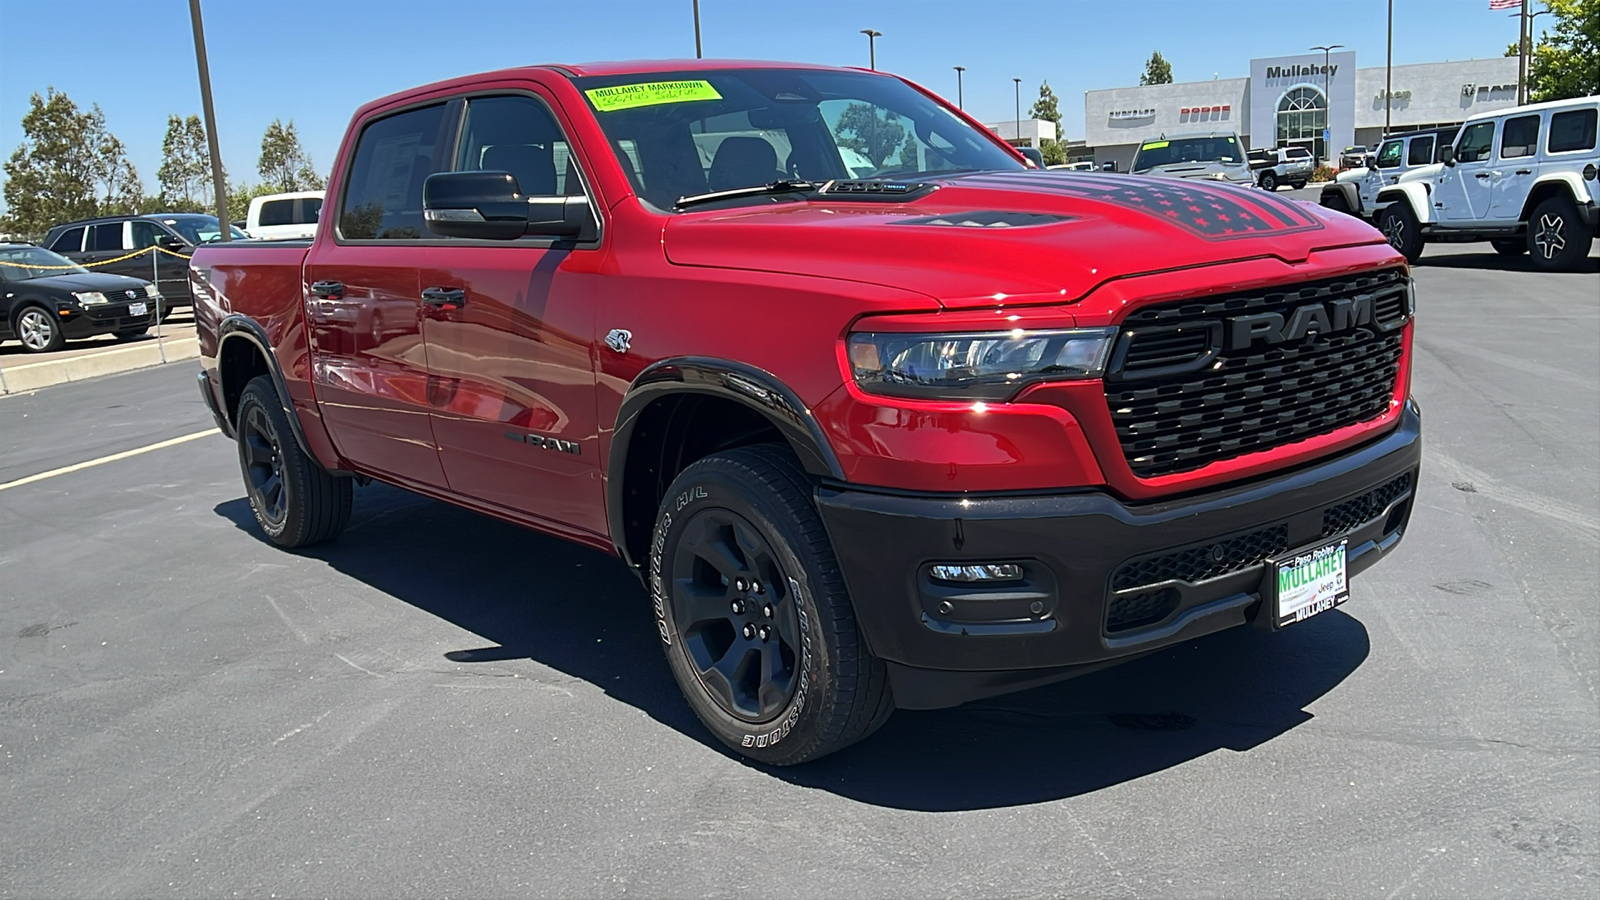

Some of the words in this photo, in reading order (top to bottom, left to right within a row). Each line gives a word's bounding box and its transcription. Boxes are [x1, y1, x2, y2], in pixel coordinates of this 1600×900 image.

[1266, 64, 1338, 79] Mullahey
[595, 85, 645, 97] MULLAHEY
[647, 82, 703, 91] MARKDOWN
[1227, 294, 1374, 350] RAM
[528, 433, 581, 455] RAM
[676, 486, 708, 511] H/L
[1279, 549, 1344, 595] MULLAHEY
[1318, 581, 1334, 594] Jeep
[1296, 595, 1335, 622] MULLAHEY
[742, 576, 811, 748] BRIDGESTONE
